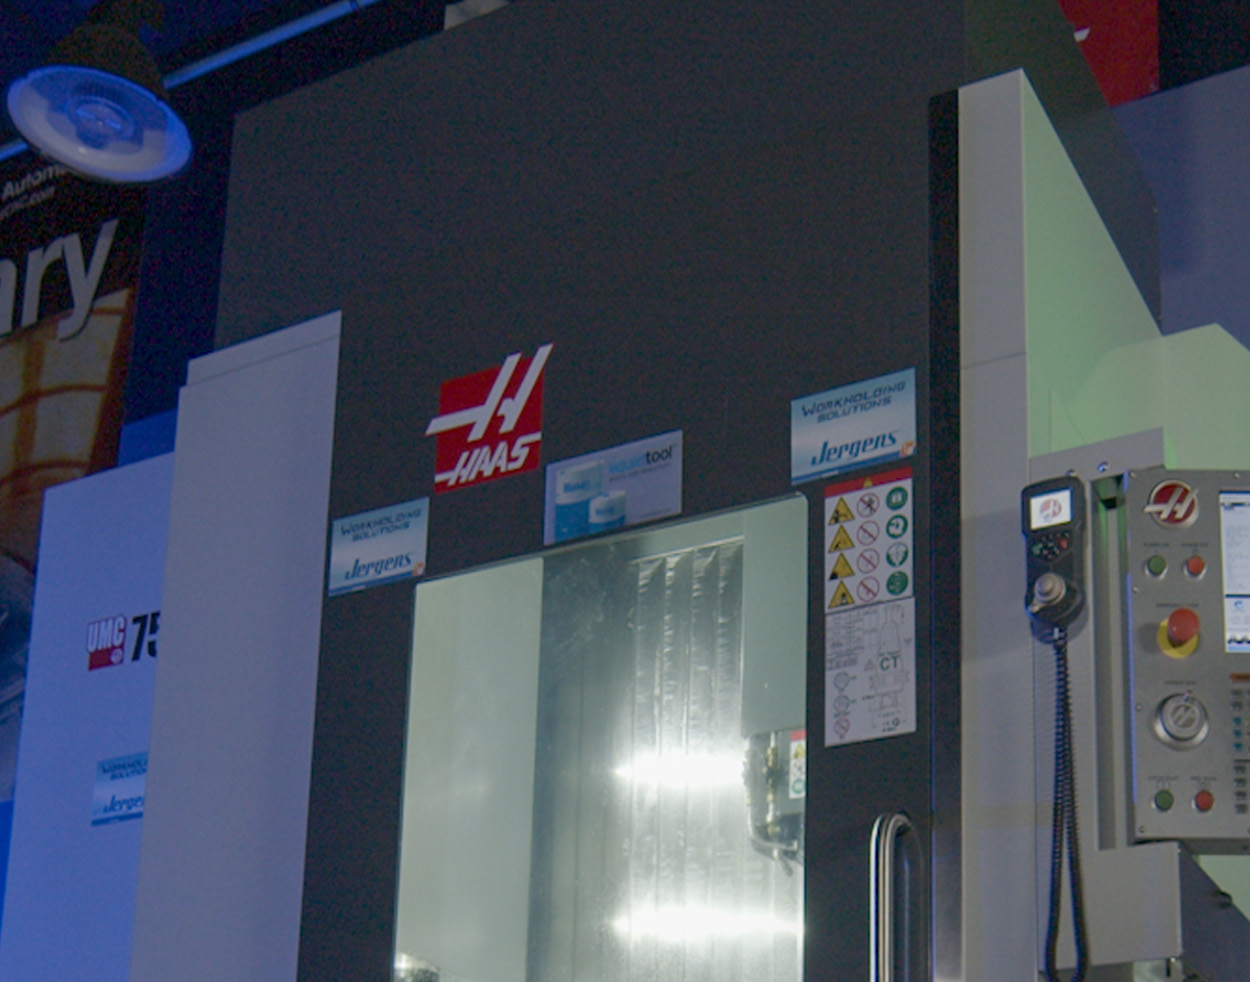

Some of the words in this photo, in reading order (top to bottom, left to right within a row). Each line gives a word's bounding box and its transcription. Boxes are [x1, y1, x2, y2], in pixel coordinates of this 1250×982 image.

[817, 395, 894, 423] SOLUTIONS
[434, 431, 542, 486] HAAS
[810, 430, 899, 467] Jergens
[344, 552, 414, 580] Jergens
[88, 616, 125, 652] UMC
[880, 653, 900, 672] CT
